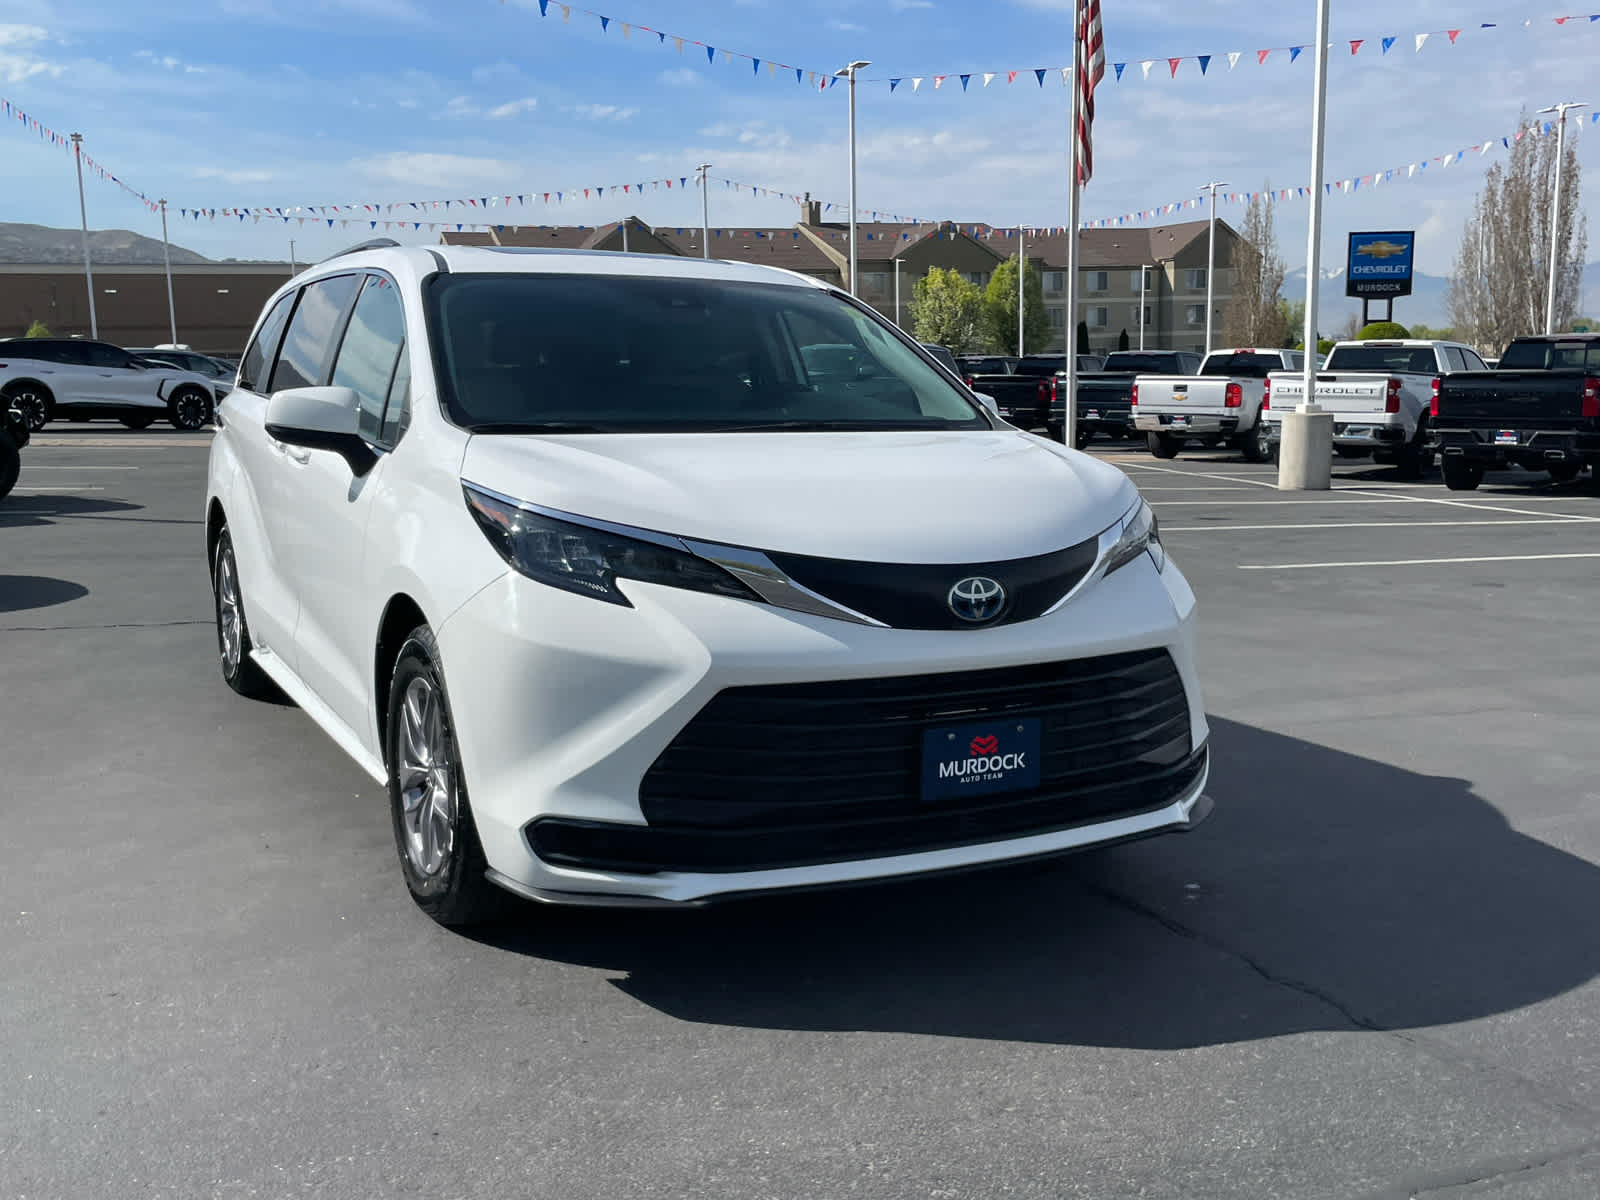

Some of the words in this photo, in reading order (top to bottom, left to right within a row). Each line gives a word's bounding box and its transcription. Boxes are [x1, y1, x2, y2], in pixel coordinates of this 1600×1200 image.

[1353, 265, 1408, 274] CHEVROLET
[939, 752, 1025, 778] MURDOCK
[960, 775, 980, 783] AUTO
[983, 772, 1003, 781] TEAM
